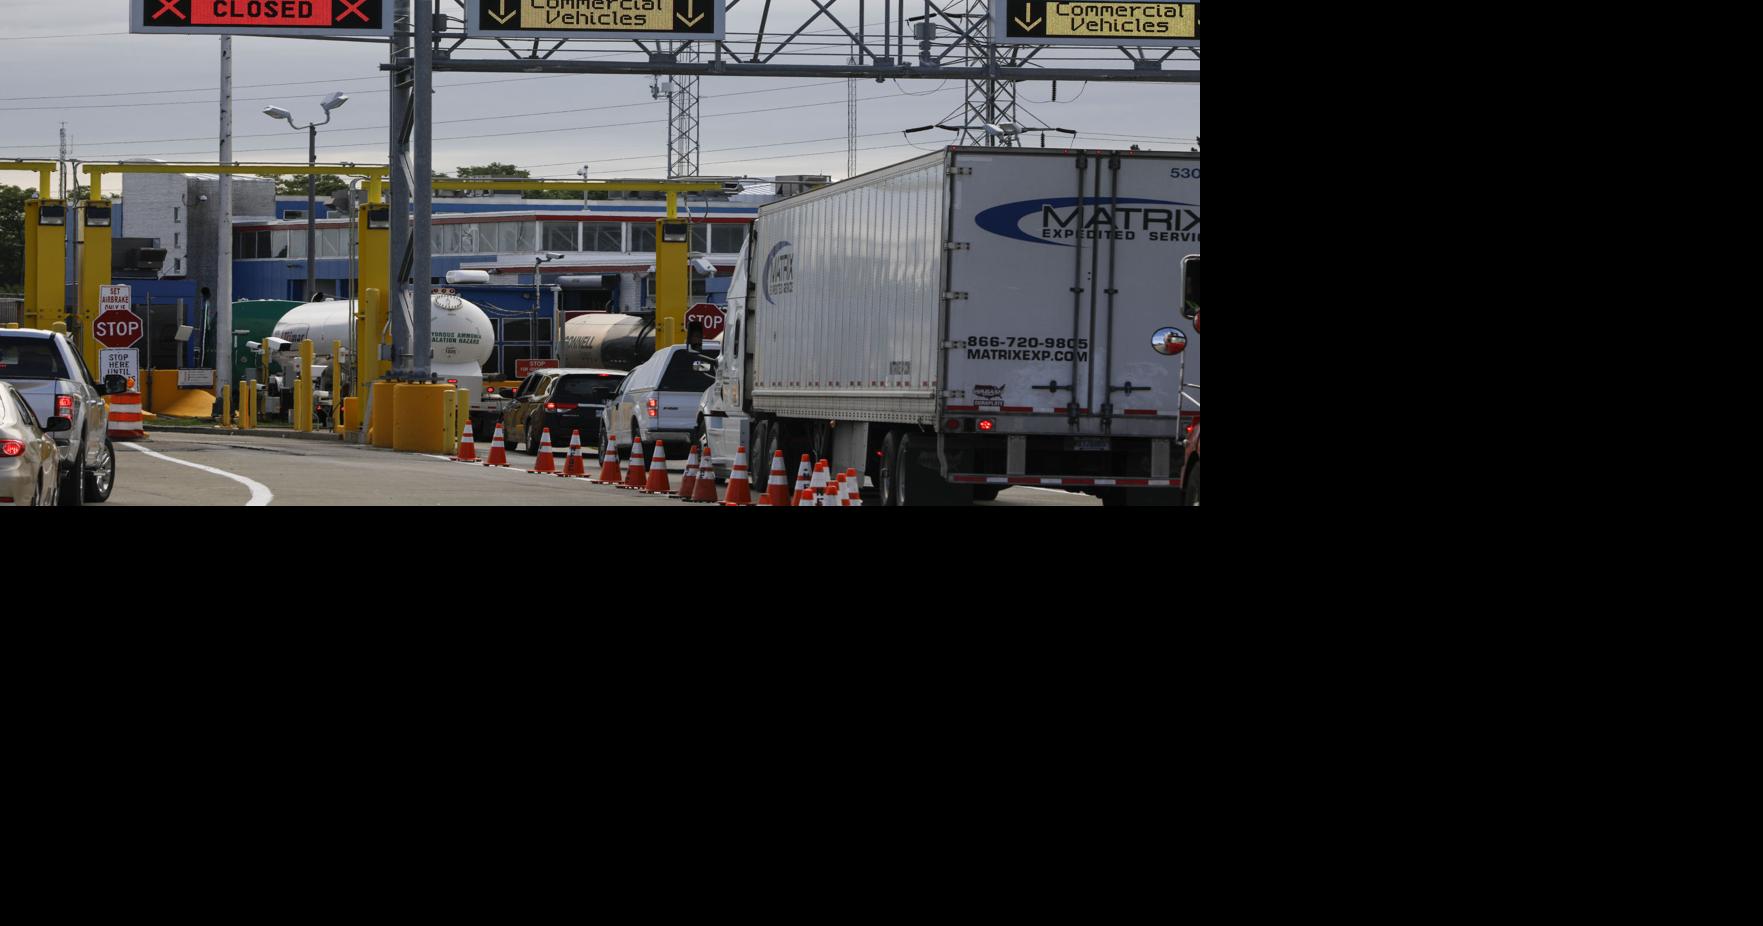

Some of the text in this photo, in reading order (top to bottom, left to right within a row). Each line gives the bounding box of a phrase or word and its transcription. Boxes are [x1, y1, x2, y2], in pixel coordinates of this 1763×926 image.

[213, 0, 313, 18] CLOSED
[531, 0, 662, 11] Commercial
[1056, 2, 1184, 18] Commercial
[546, 11, 647, 26] Vehicles
[1071, 17, 1169, 33] Vehicles
[1042, 204, 1200, 231] MATRIX
[110, 287, 121, 295] SET
[96, 321, 139, 337] STOP
[688, 314, 723, 329] STOP
[967, 336, 1088, 350] 866-720-9805
[108, 353, 129, 361] STOP
[967, 349, 1088, 362] MATRIXEXP.COM
